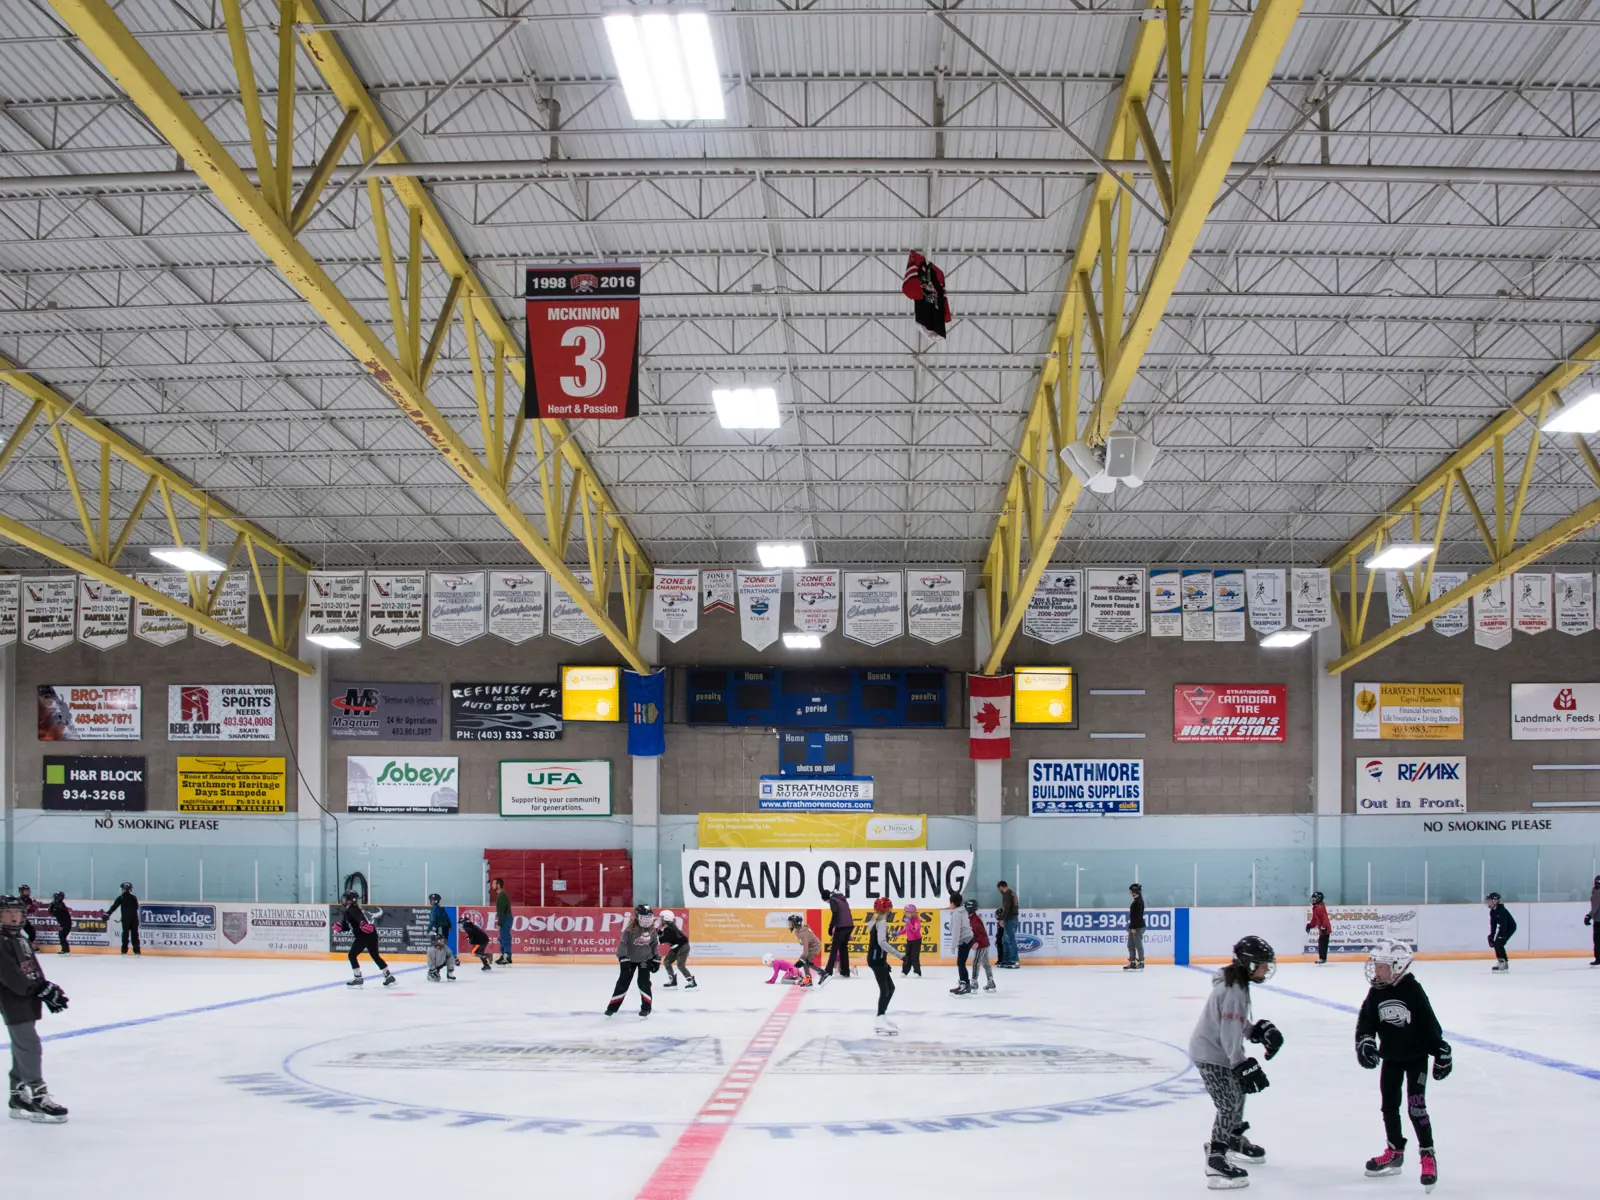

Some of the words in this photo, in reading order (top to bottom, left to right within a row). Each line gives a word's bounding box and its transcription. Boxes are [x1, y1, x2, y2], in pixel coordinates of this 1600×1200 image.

[532, 278, 566, 288] 1998
[600, 276, 635, 288] 2016
[548, 307, 620, 320] MCKINNON
[560, 325, 606, 398] 3
[548, 405, 572, 414] Heart
[574, 405, 580, 413] &
[584, 404, 618, 413] Passion
[432, 604, 482, 618] Champions
[491, 604, 542, 618] Champions
[847, 604, 900, 618] Champions
[909, 604, 962, 618] Champions
[83, 627, 128, 639] Champions
[140, 622, 186, 634] Champions
[372, 624, 421, 636] Champions
[28, 628, 73, 640] Champions
[745, 672, 763, 680] Home
[868, 672, 891, 680] Guests
[71, 688, 136, 702] BRO-TECH
[452, 686, 532, 698] REFINISH
[696, 692, 721, 702] penalty
[911, 692, 936, 701] penalty
[222, 696, 270, 708] SPORTS
[462, 701, 492, 710] AUTO
[805, 704, 828, 714] period
[1235, 705, 1260, 713] TIRE
[332, 718, 378, 728] Magnum
[1514, 714, 1562, 722] Landmark
[1566, 714, 1594, 722] Feeds
[170, 723, 190, 734] REBEL
[192, 723, 220, 734] SPORTS
[1181, 726, 1238, 736] HOCKEY
[1237, 726, 1280, 736] STORE
[456, 731, 474, 739] PH:
[478, 731, 502, 740] (403)
[506, 731, 522, 739] 533
[532, 731, 556, 739] 3830
[786, 734, 804, 742] Home
[824, 733, 848, 742] Guests
[376, 760, 455, 786] Sobeys
[796, 764, 812, 772] shots
[824, 764, 836, 773] goal
[1033, 763, 1140, 782] STRATHMORE
[1398, 762, 1460, 782] RE/MAX
[70, 770, 97, 780] H&R
[100, 770, 142, 781] BLOCK
[528, 773, 582, 784] UFA
[239, 781, 280, 790] Heritage
[63, 790, 125, 800] 934-3268
[195, 788, 218, 797] Days
[220, 789, 266, 798] Stampede
[1033, 785, 1084, 798] BUILDING
[1088, 785, 1140, 798] SUPPLIES
[512, 796, 548, 804] Supporting
[566, 796, 600, 804] community
[1360, 798, 1388, 808] Out
[1396, 798, 1411, 808] in
[95, 818, 112, 829] NO
[118, 819, 174, 830] SMOKING
[180, 820, 219, 830] PLEASE
[883, 824, 914, 833] Chinook
[1424, 822, 1442, 832] NO
[1448, 821, 1507, 832] SMOKING
[1512, 820, 1552, 830] PLEASE
[689, 860, 806, 899] GRAND
[818, 860, 966, 899] OPENING
[142, 910, 212, 926] Travelodge
[250, 909, 296, 918] STRATHMORE
[296, 910, 327, 919] STATION
[1063, 914, 1170, 928] 403-934-100
